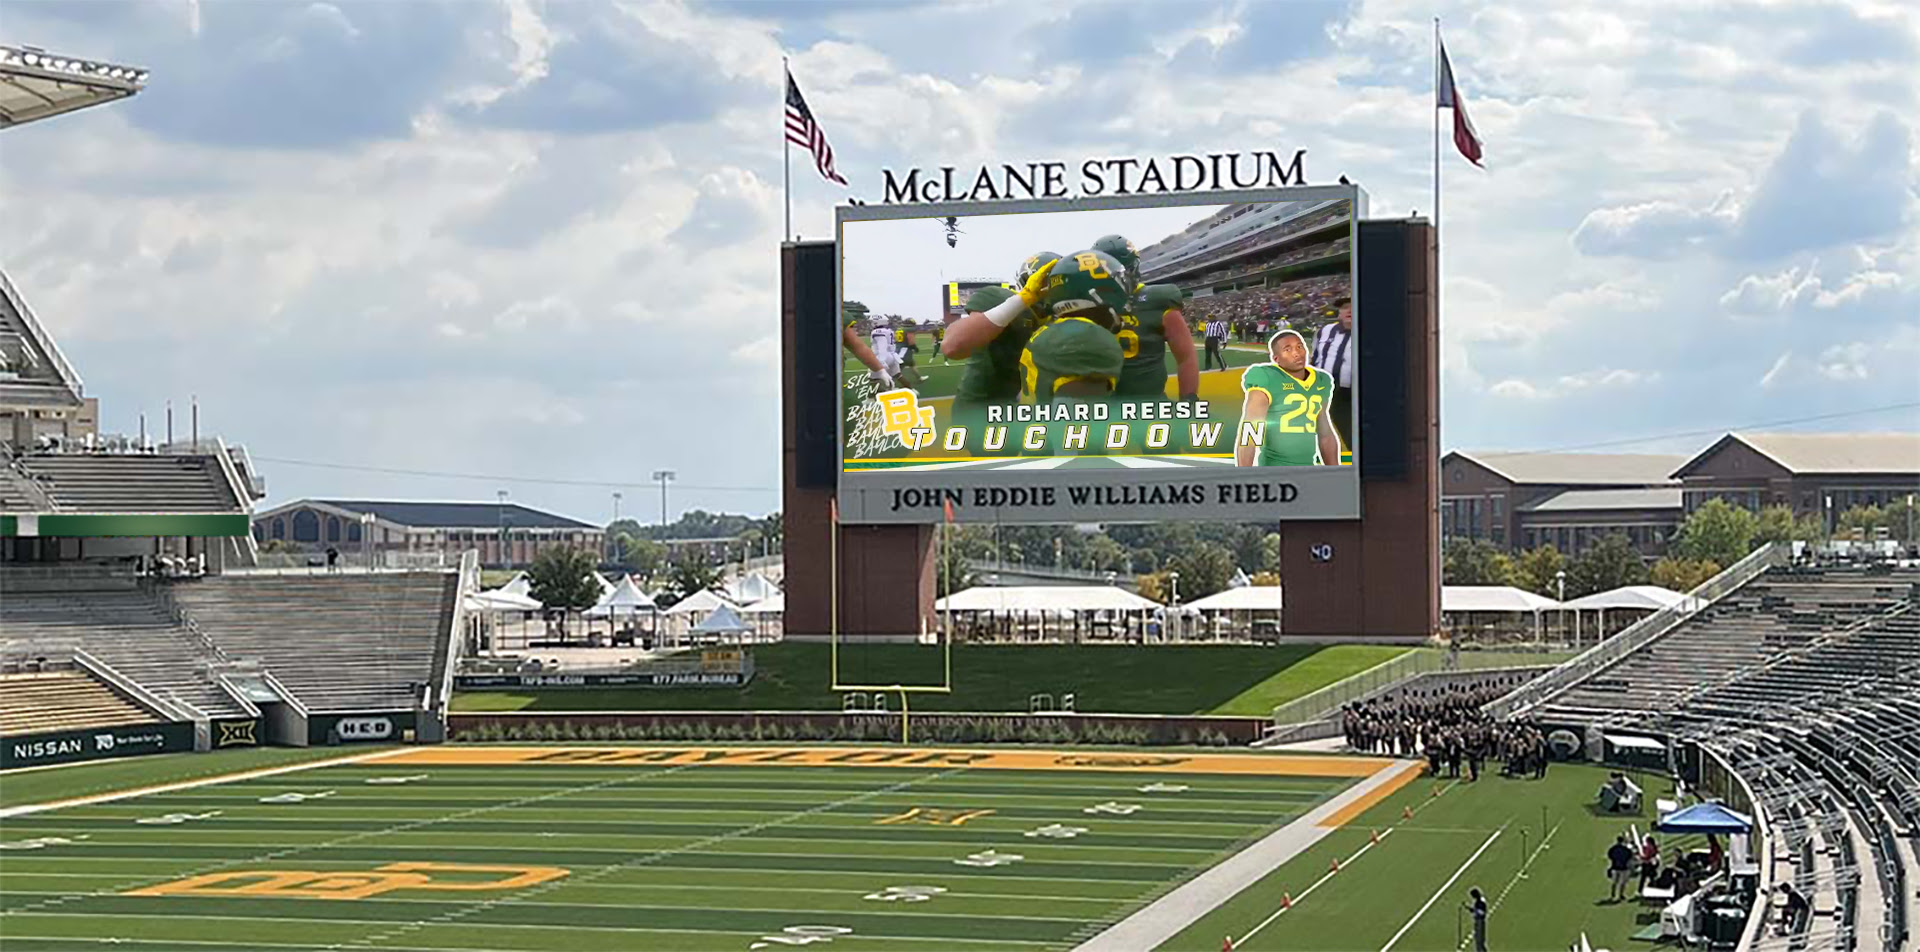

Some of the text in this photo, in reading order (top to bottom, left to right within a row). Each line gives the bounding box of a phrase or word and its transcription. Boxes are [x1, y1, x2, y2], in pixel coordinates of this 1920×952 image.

[882, 150, 1307, 203] McLANE STADIUM
[847, 372, 871, 389] SIC
[987, 401, 1210, 422] RICHARD REESE
[1279, 393, 1322, 433] 29
[853, 433, 904, 459] BAYLO
[911, 421, 1265, 452] TOUCHDOWN
[892, 483, 1298, 511] JOHN EDDIE WILLIAMS FIELD
[1311, 545, 1331, 560] 40
[14, 739, 82, 758] NISSAN
[520, 750, 996, 766] BAYLOR
[119, 862, 572, 899] BU
